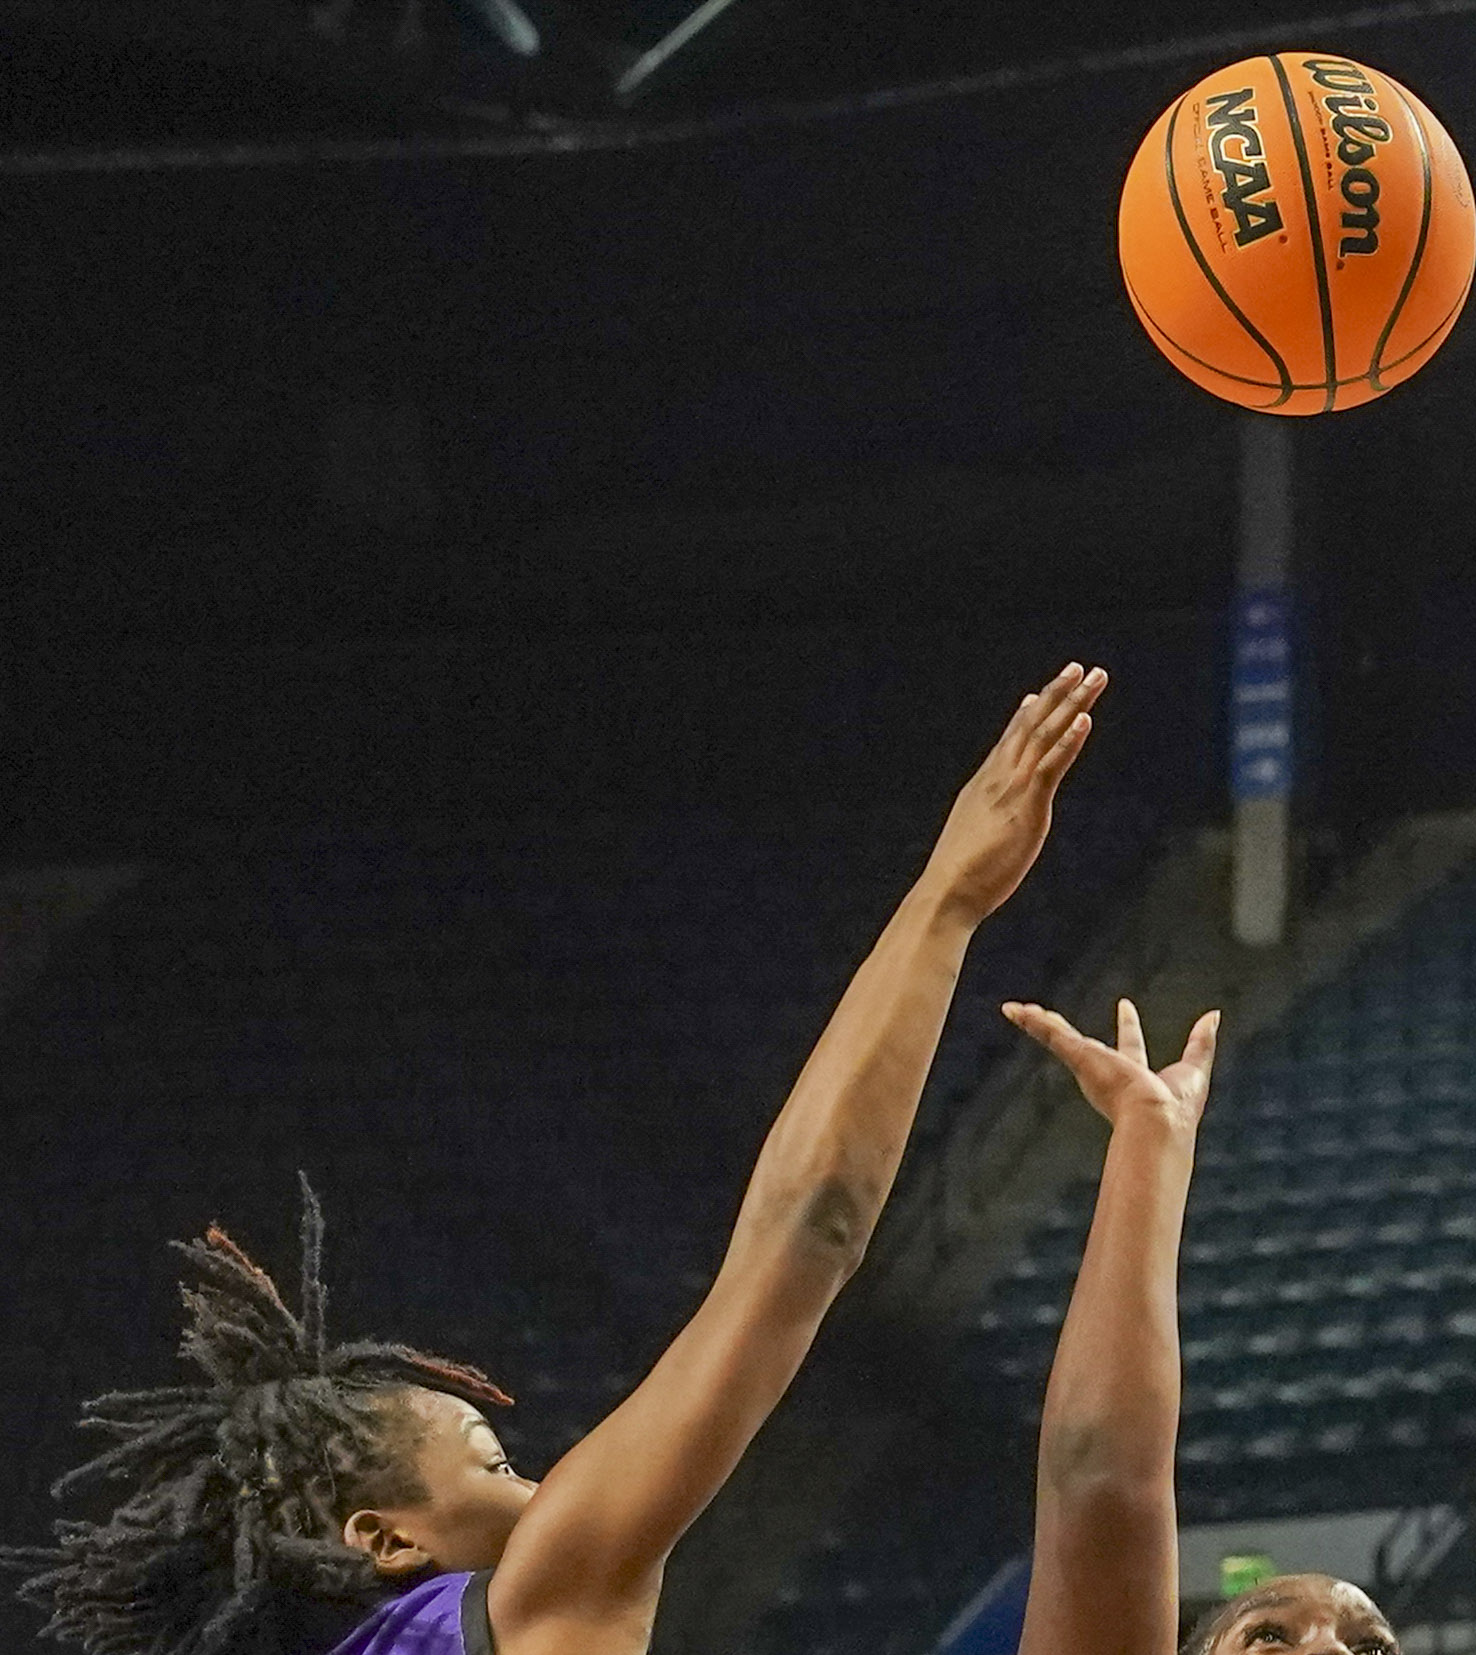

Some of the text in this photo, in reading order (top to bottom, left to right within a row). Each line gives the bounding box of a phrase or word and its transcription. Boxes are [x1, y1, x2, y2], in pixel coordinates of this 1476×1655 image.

[1199, 157, 1215, 204] GAME
[1210, 207, 1228, 253] BALL
[1205, 87, 1285, 249] NCAA
[1302, 59, 1393, 258] Wilson
